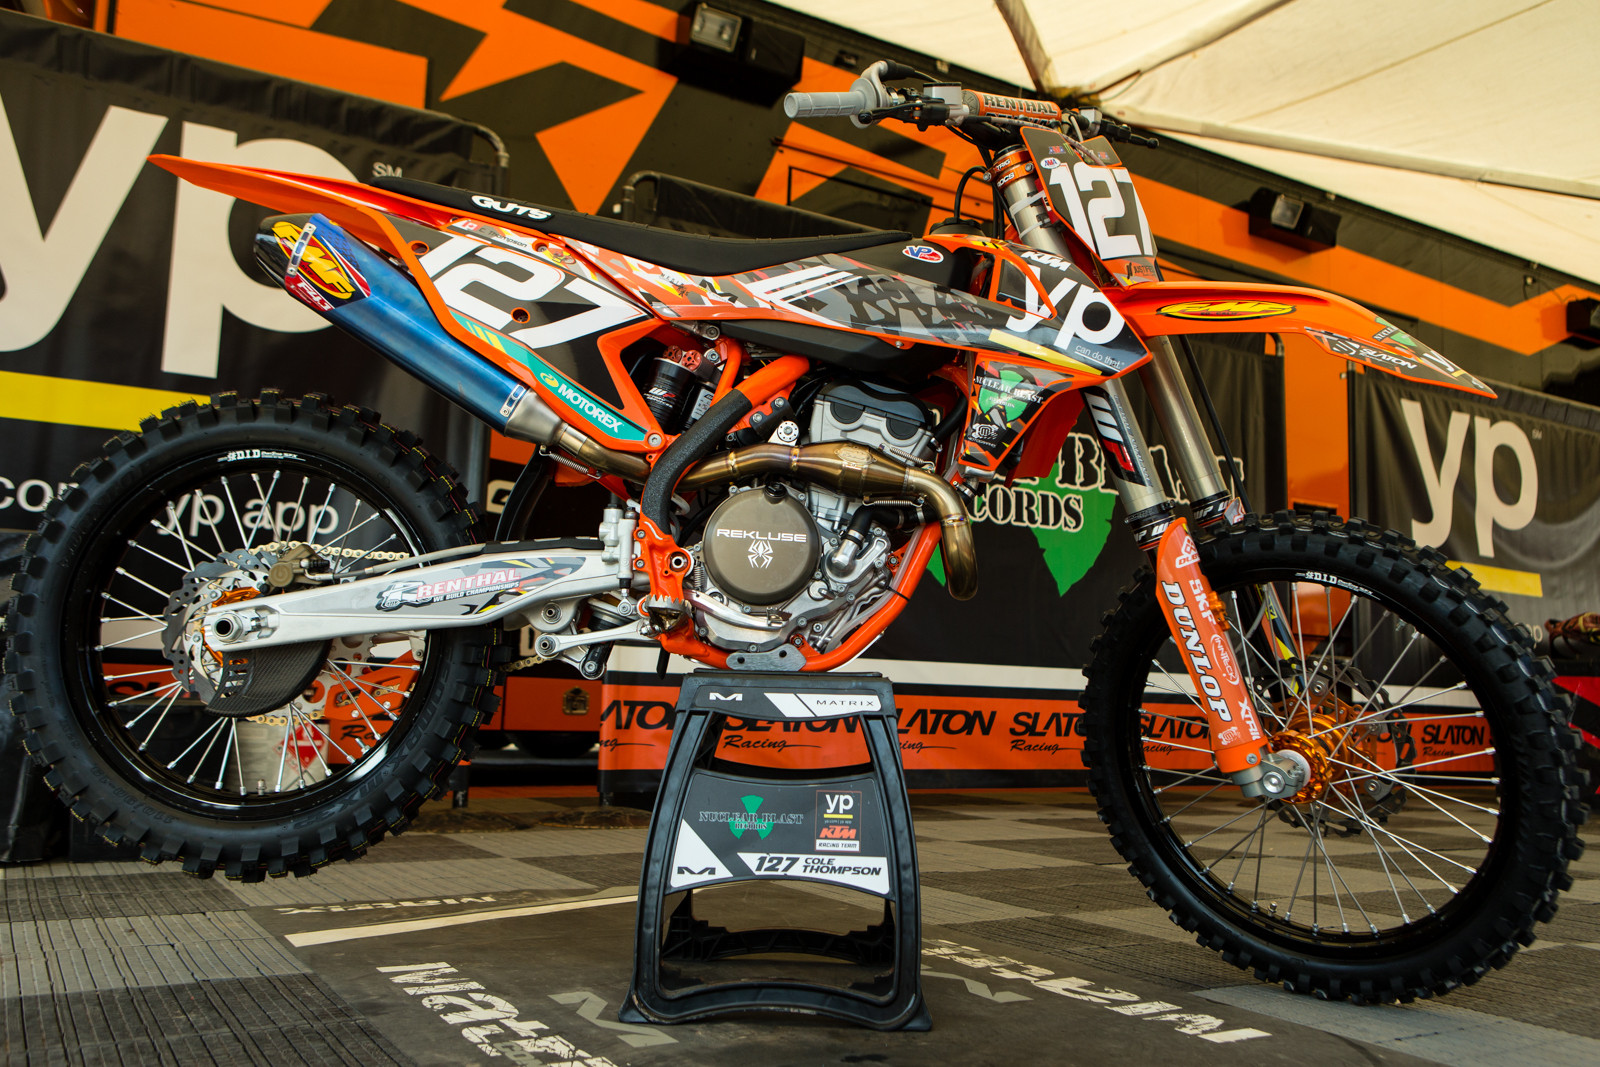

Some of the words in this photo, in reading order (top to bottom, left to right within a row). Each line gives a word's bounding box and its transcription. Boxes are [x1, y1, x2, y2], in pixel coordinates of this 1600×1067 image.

[983, 95, 1058, 116] RENTHAL
[471, 195, 552, 220] GUTS
[1049, 161, 1157, 261] 127
[0, 92, 362, 378] yp
[272, 223, 356, 294] FMF
[908, 246, 933, 258] VP
[1021, 251, 1071, 272] KTM
[418, 237, 649, 350] 127
[1005, 265, 1126, 350] yp
[1075, 344, 1091, 356] can
[1092, 349, 1103, 361] do
[974, 376, 1012, 394] NUCLEAR
[557, 383, 625, 434] MOTOREX
[1400, 398, 1539, 558] yp
[0, 475, 79, 513] co
[156, 490, 225, 536] yp
[242, 498, 339, 536] app
[967, 487, 1084, 533] CORDS
[716, 528, 807, 543] REKLUSE
[416, 568, 521, 600] RENTHAL
[433, 594, 445, 603] WE
[446, 591, 465, 601] BUILD
[466, 581, 520, 599] CHAMPIONSHIPS
[1188, 578, 1218, 626] SKF
[1161, 580, 1233, 722] DUNLOP
[816, 699, 874, 707] MATRIX
[896, 708, 997, 736] LATON
[1009, 712, 1088, 738] SLAT
[723, 735, 790, 752] Racing
[1421, 724, 1484, 746] SLATON
[1010, 739, 1061, 755] Racing
[1142, 745, 1174, 756] acing
[825, 794, 854, 814] yp
[698, 810, 758, 823] NUCLEAR
[761, 812, 804, 825] BLAST
[819, 825, 857, 840] KTM
[755, 855, 800, 873] 127
[802, 865, 882, 877] THOMPSON
[804, 857, 836, 866] COLE
